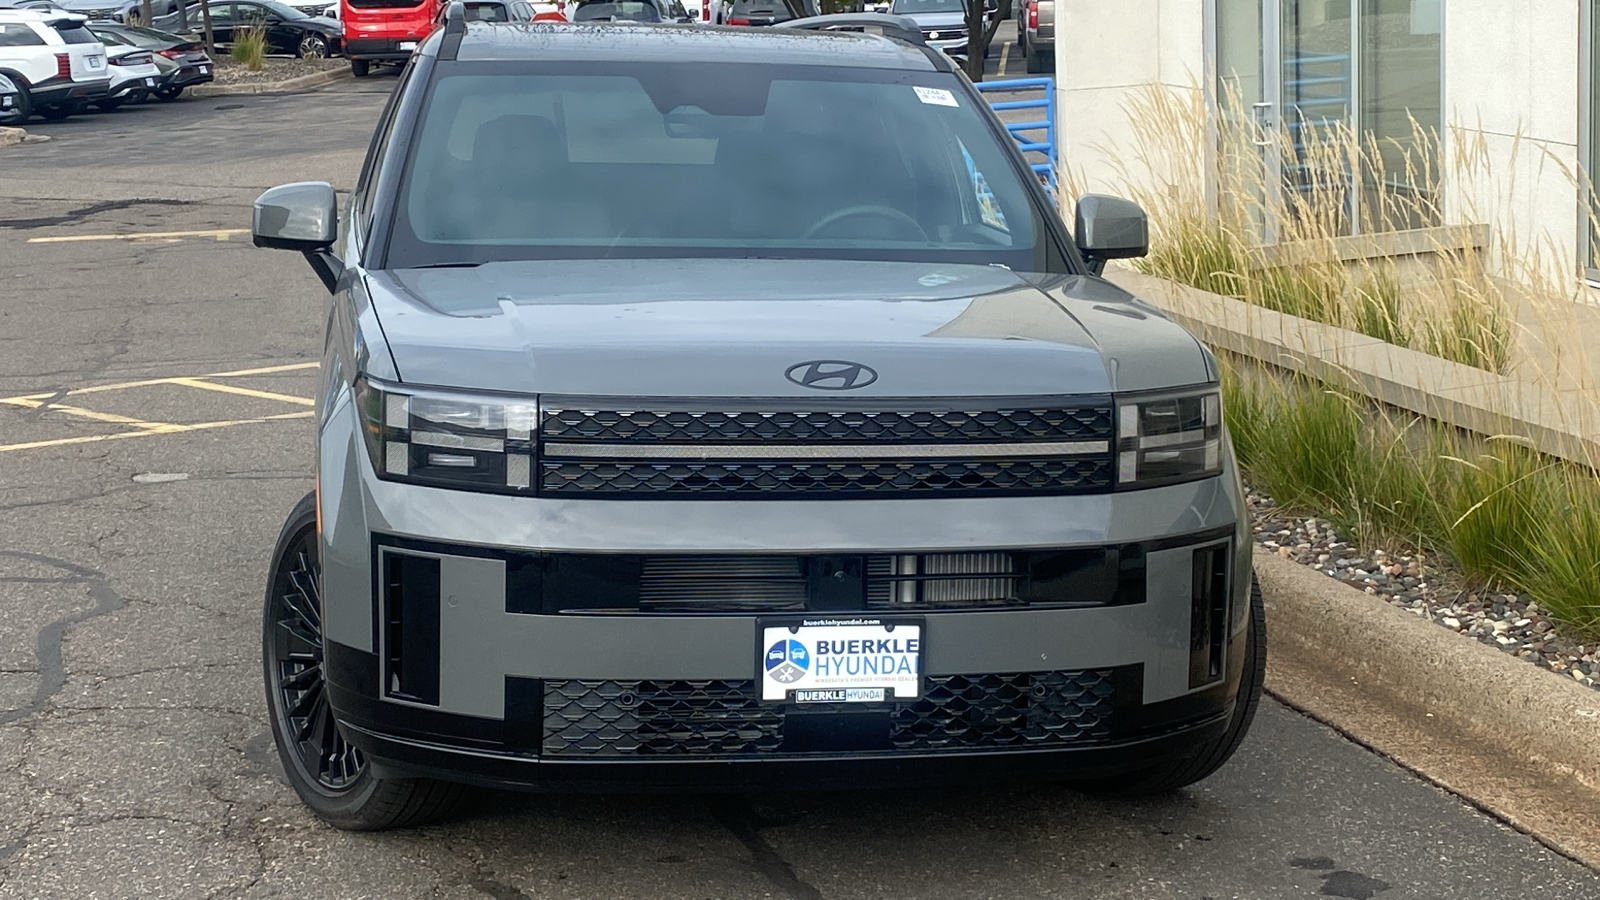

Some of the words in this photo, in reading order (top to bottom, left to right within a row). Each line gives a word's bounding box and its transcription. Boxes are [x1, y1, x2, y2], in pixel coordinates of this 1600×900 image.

[803, 619, 880, 627] buerklehyundai.com
[816, 638, 919, 655] BUERKLE
[797, 690, 846, 701] BUERKLE
[847, 689, 883, 700] HYUNDAI
